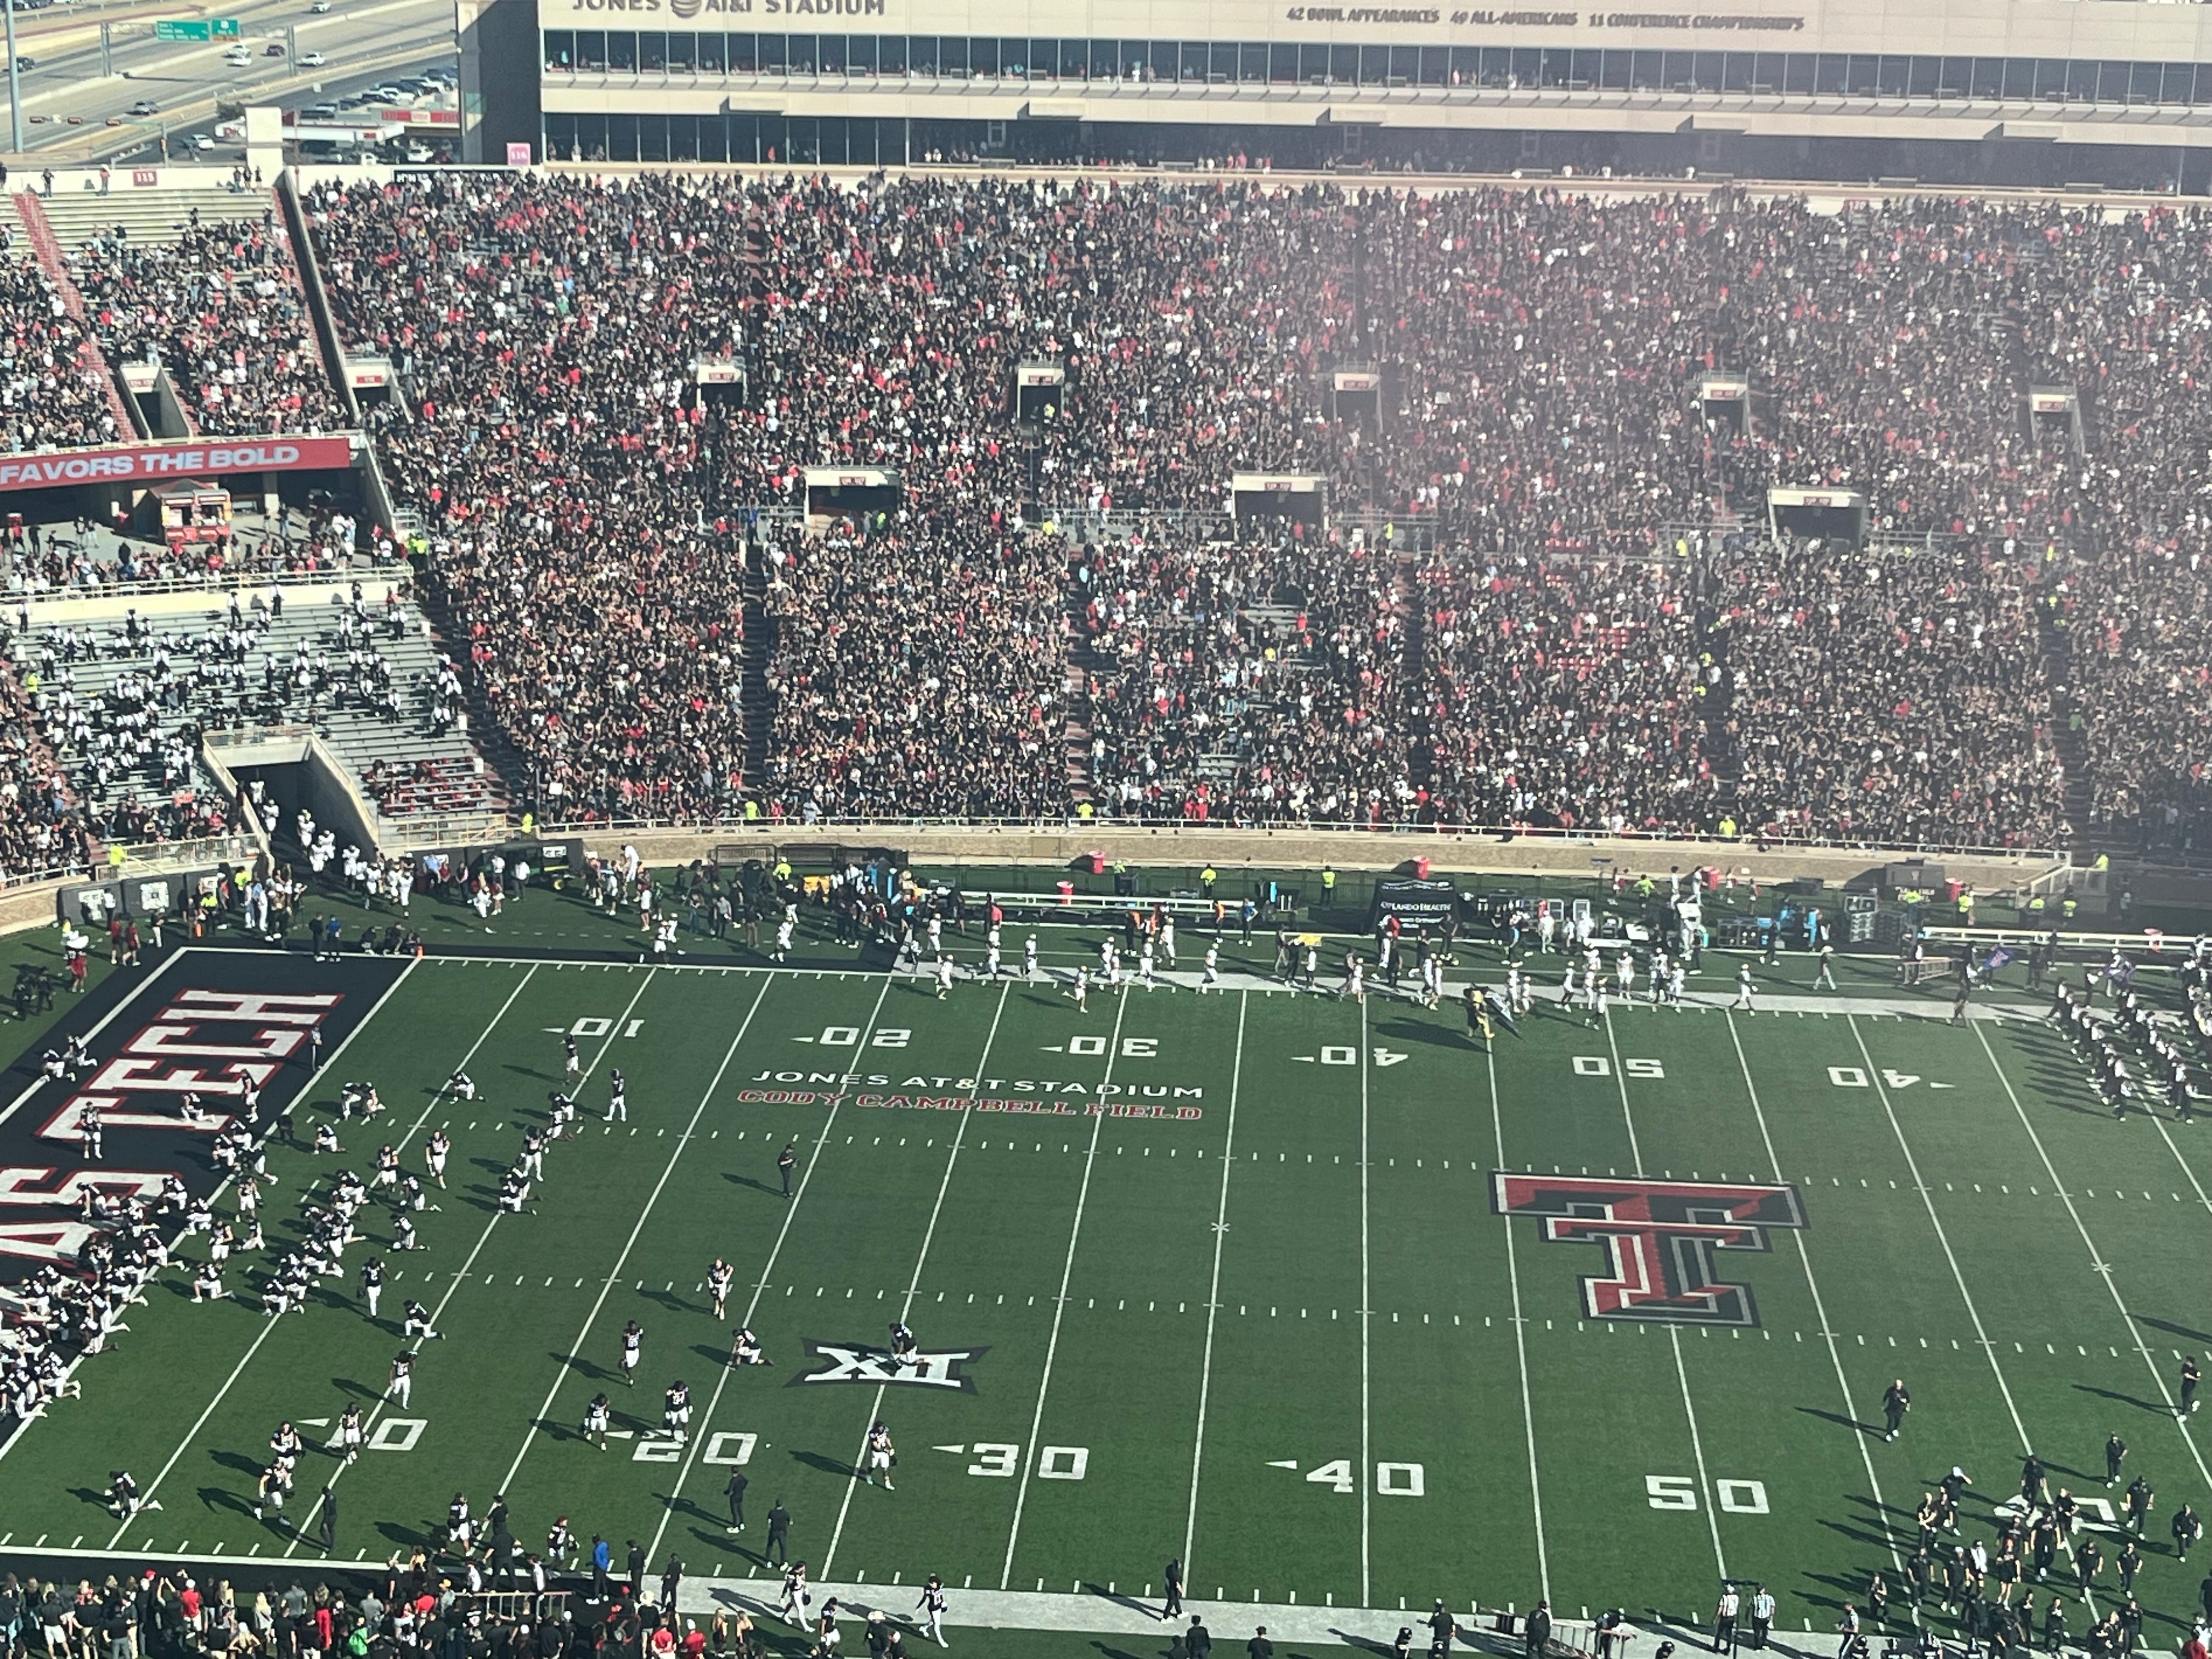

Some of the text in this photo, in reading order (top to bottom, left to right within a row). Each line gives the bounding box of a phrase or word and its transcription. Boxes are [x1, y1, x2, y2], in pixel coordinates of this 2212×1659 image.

[766, 0, 884, 15] STADIUM
[1286, 7, 1305, 20] 42
[1347, 8, 1440, 23] APPEARANCES
[1470, 11, 1578, 25] ALL-AMERICANS
[1589, 14, 1805, 31] 11 CONFERENCE CHAMPIONSHIPS
[0, 446, 300, 484] FAVORS THE BOLD
[820, 1026, 912, 1047] 20
[1069, 1036, 1159, 1057] 30
[36, 988, 346, 1141] TECH
[1321, 1045, 1408, 1066] 40
[1572, 1056, 1665, 1079] 50
[1827, 1066, 1920, 1088] 40
[752, 1071, 1203, 1098] JONES AT&T STADIUM
[737, 1090, 1203, 1120] CODY CAMPBELL FIELD
[633, 1429, 757, 1465] 20
[968, 1443, 1089, 1480] 30
[1306, 1459, 1424, 1496] 40
[1645, 1475, 1770, 1514] 50
